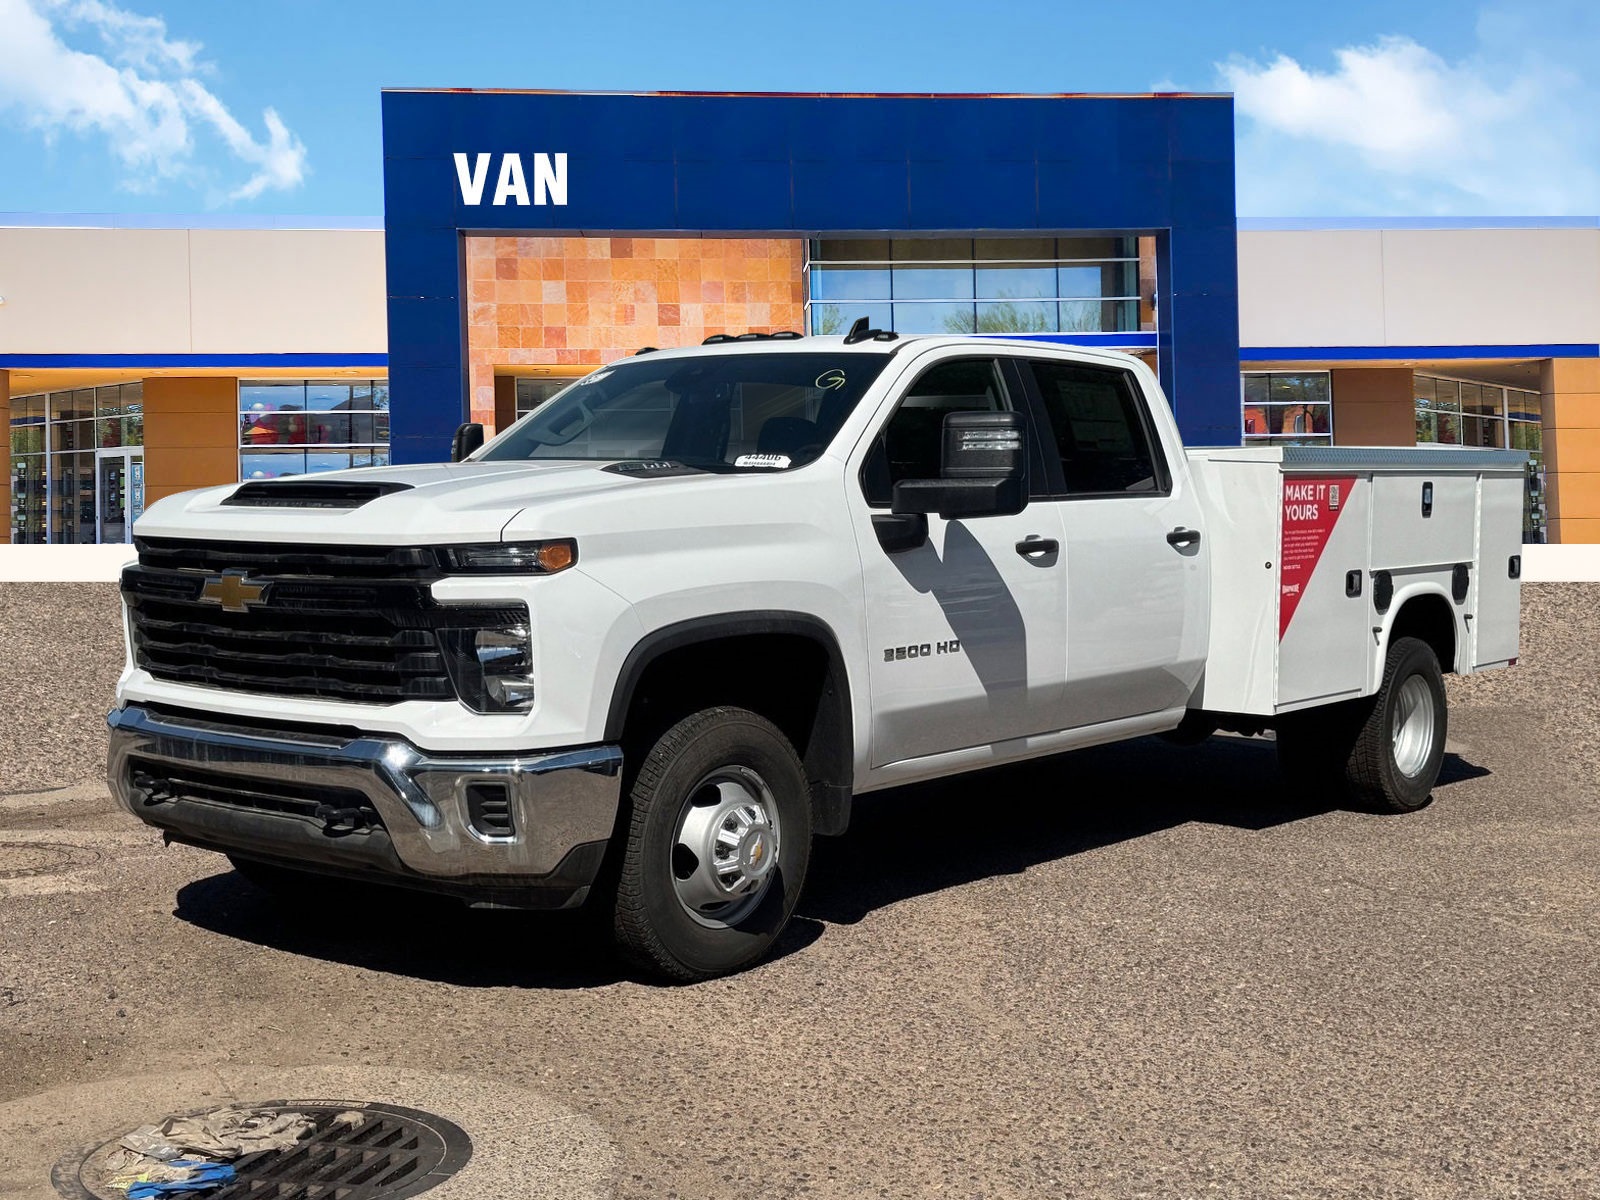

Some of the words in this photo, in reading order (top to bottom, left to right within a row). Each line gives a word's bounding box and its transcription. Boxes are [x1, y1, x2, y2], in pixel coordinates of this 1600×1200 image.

[453, 152, 568, 206] VAN
[1285, 485, 1314, 501] MAKE
[1316, 484, 1326, 500] IT
[1285, 504, 1318, 521] YOURS
[883, 643, 931, 662] 3500
[936, 640, 960, 655] HD
